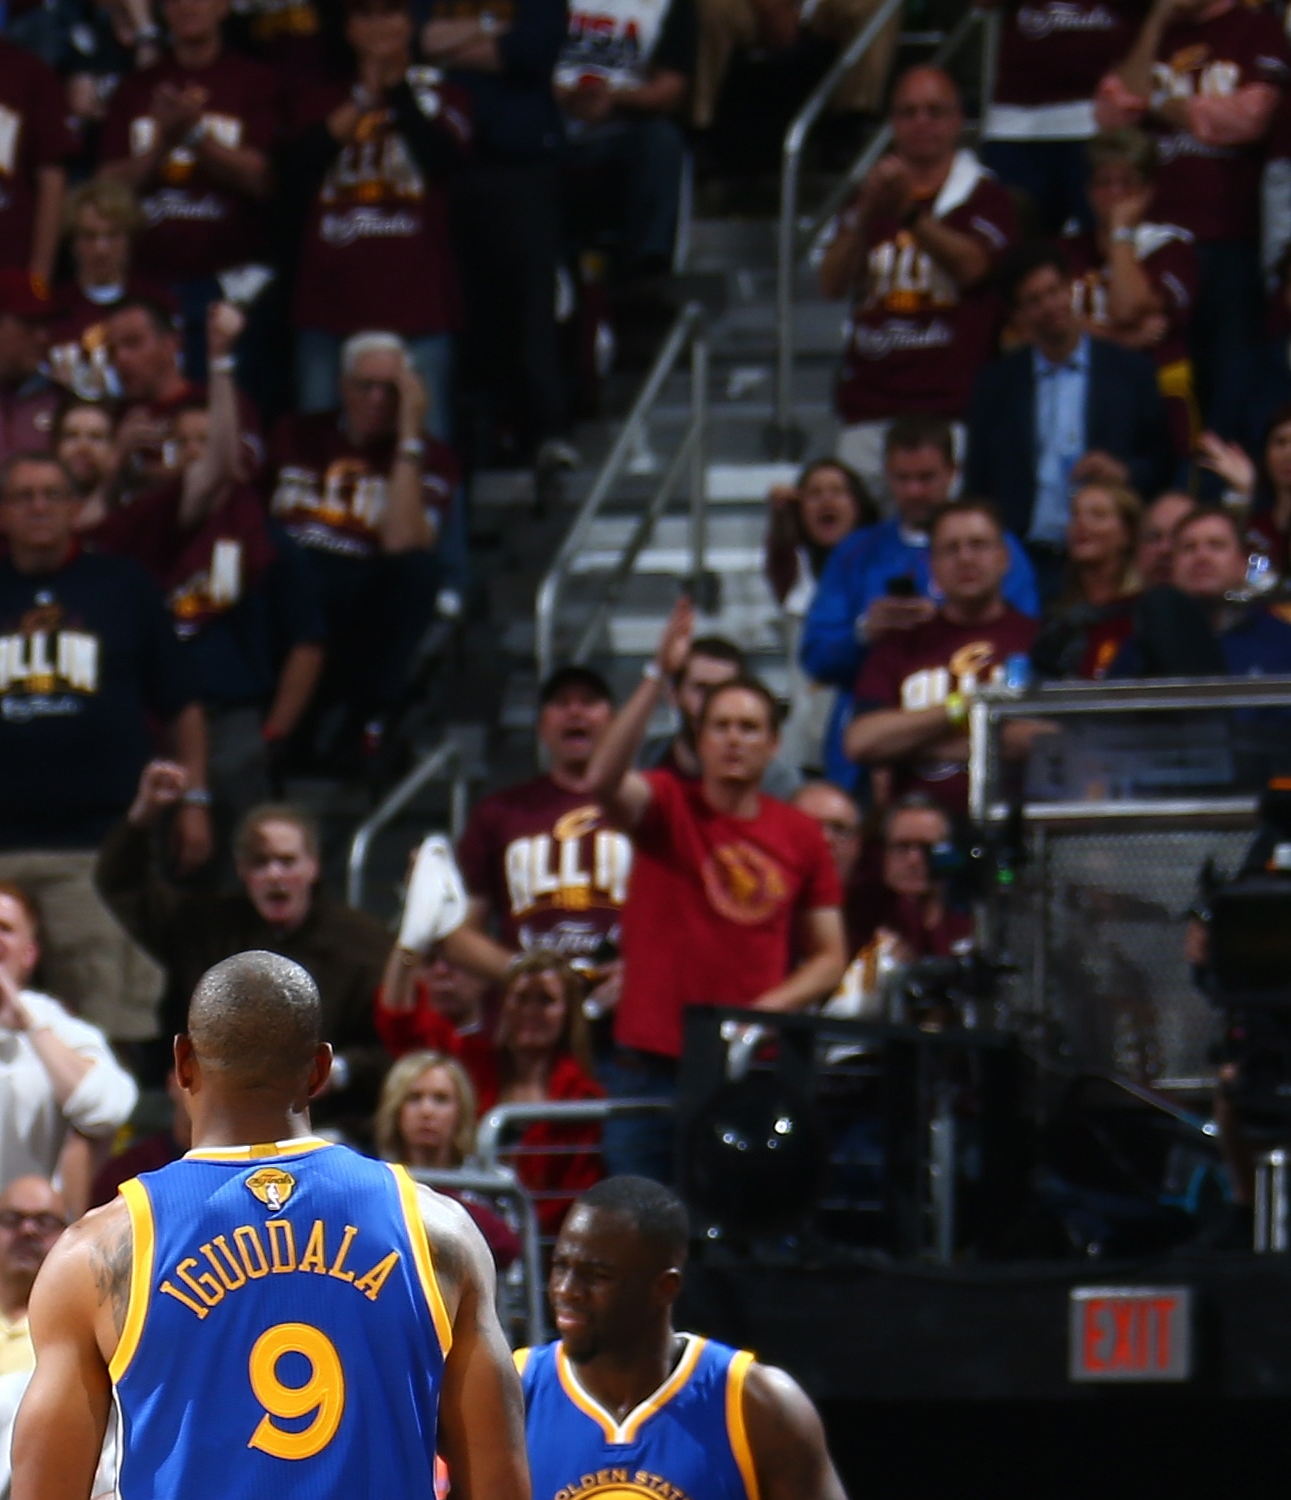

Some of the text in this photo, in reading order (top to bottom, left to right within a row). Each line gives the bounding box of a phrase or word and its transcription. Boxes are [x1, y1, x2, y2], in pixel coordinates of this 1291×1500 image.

[505, 831, 591, 917] ALL
[159, 1219, 400, 1319] IGUODALA
[1084, 1299, 1174, 1371] EXIT
[248, 1322, 346, 1460] 9
